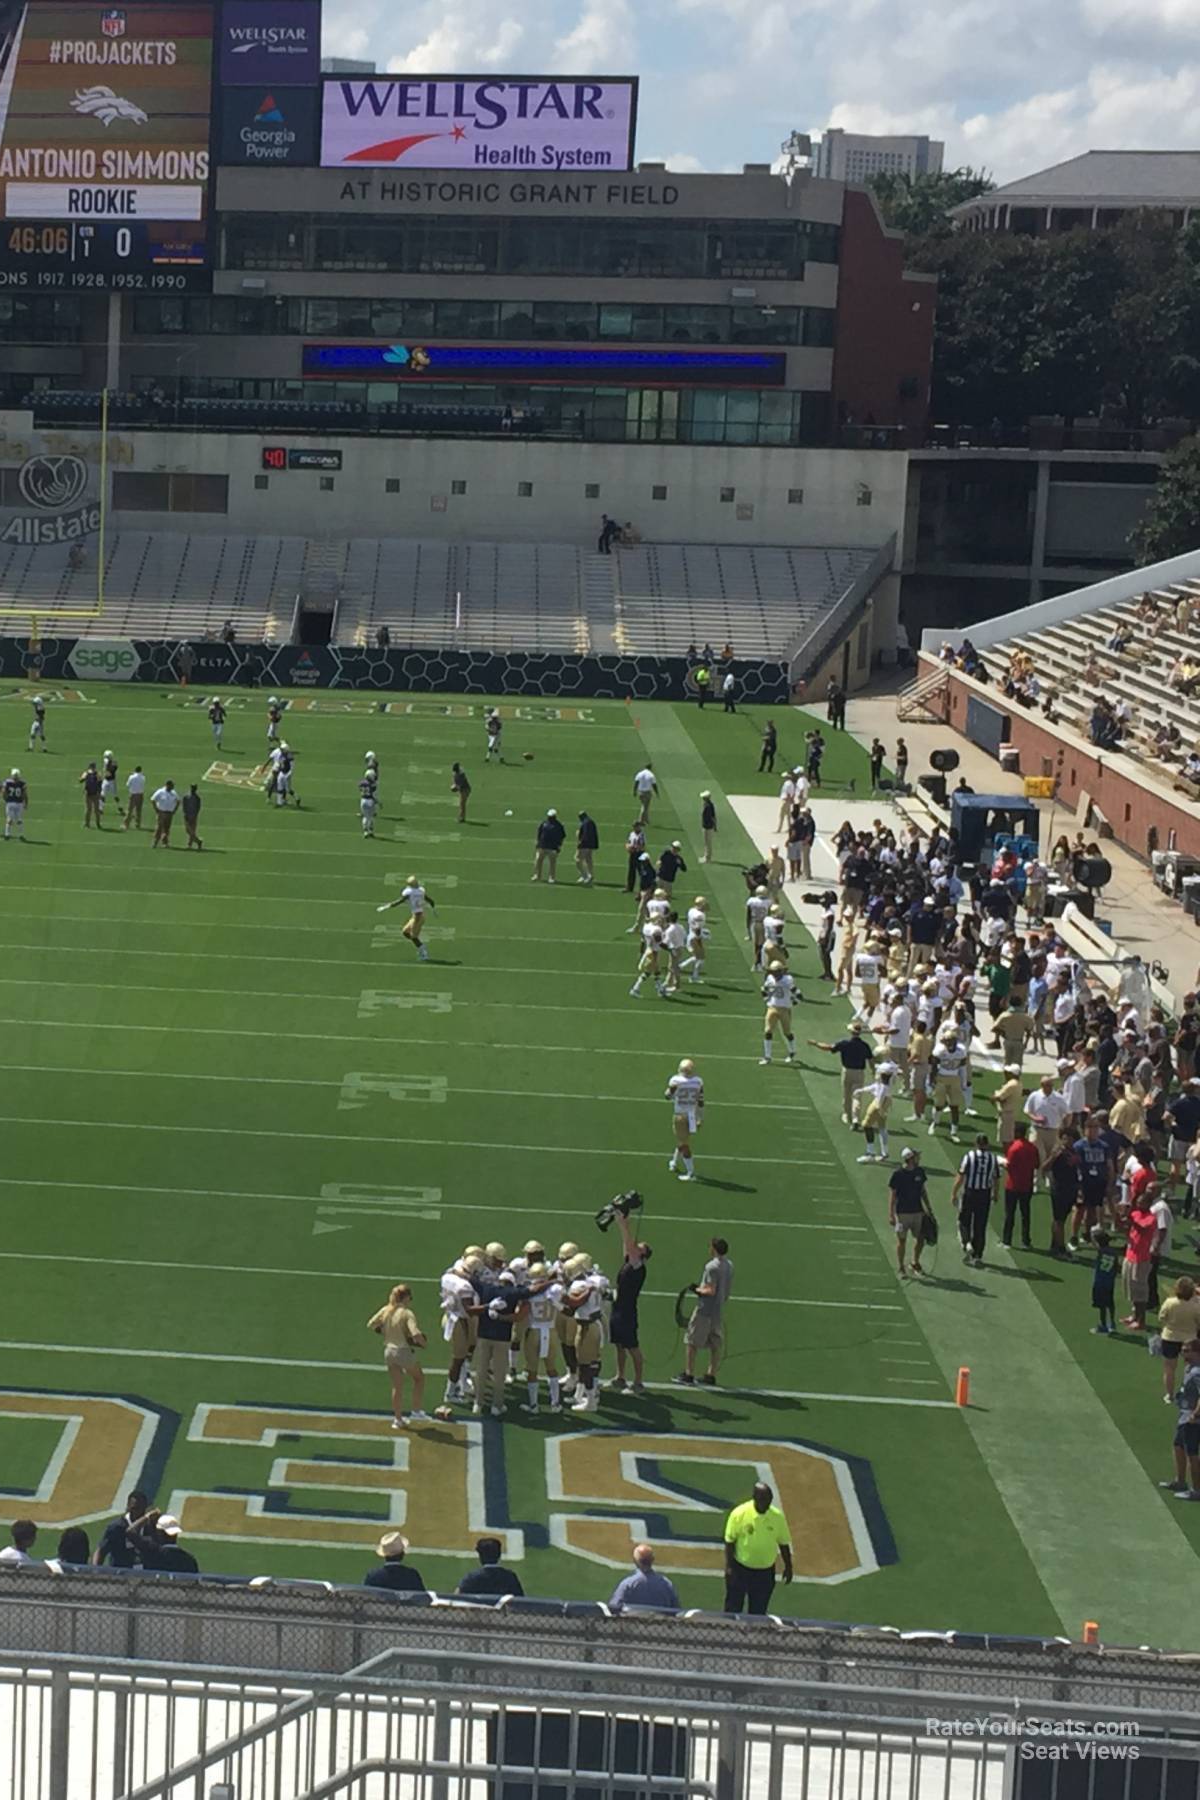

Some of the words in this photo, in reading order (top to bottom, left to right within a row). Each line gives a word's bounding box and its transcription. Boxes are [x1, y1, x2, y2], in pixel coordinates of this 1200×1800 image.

[229, 27, 306, 43] WELLSTAR
[49, 41, 177, 66] #PROJACKETS
[340, 82, 605, 130] WELLSTAR
[239, 127, 296, 147] Georgia
[0, 147, 96, 180] ANTONIO
[101, 149, 209, 181] SIMMONS
[245, 143, 290, 160] Power
[474, 143, 537, 166] Health
[541, 145, 612, 171] System
[67, 188, 138, 215] ROOKIE
[340, 181, 369, 200] AT
[379, 181, 500, 202] HISTORIC
[509, 183, 594, 204] GRANT
[607, 185, 680, 206] FIELD
[8, 227, 68, 255] 46:06
[116, 227, 132, 257] 0
[151, 274, 187, 289] 1990
[1, 508, 101, 544] Allstate
[75, 650, 135, 672] sage
